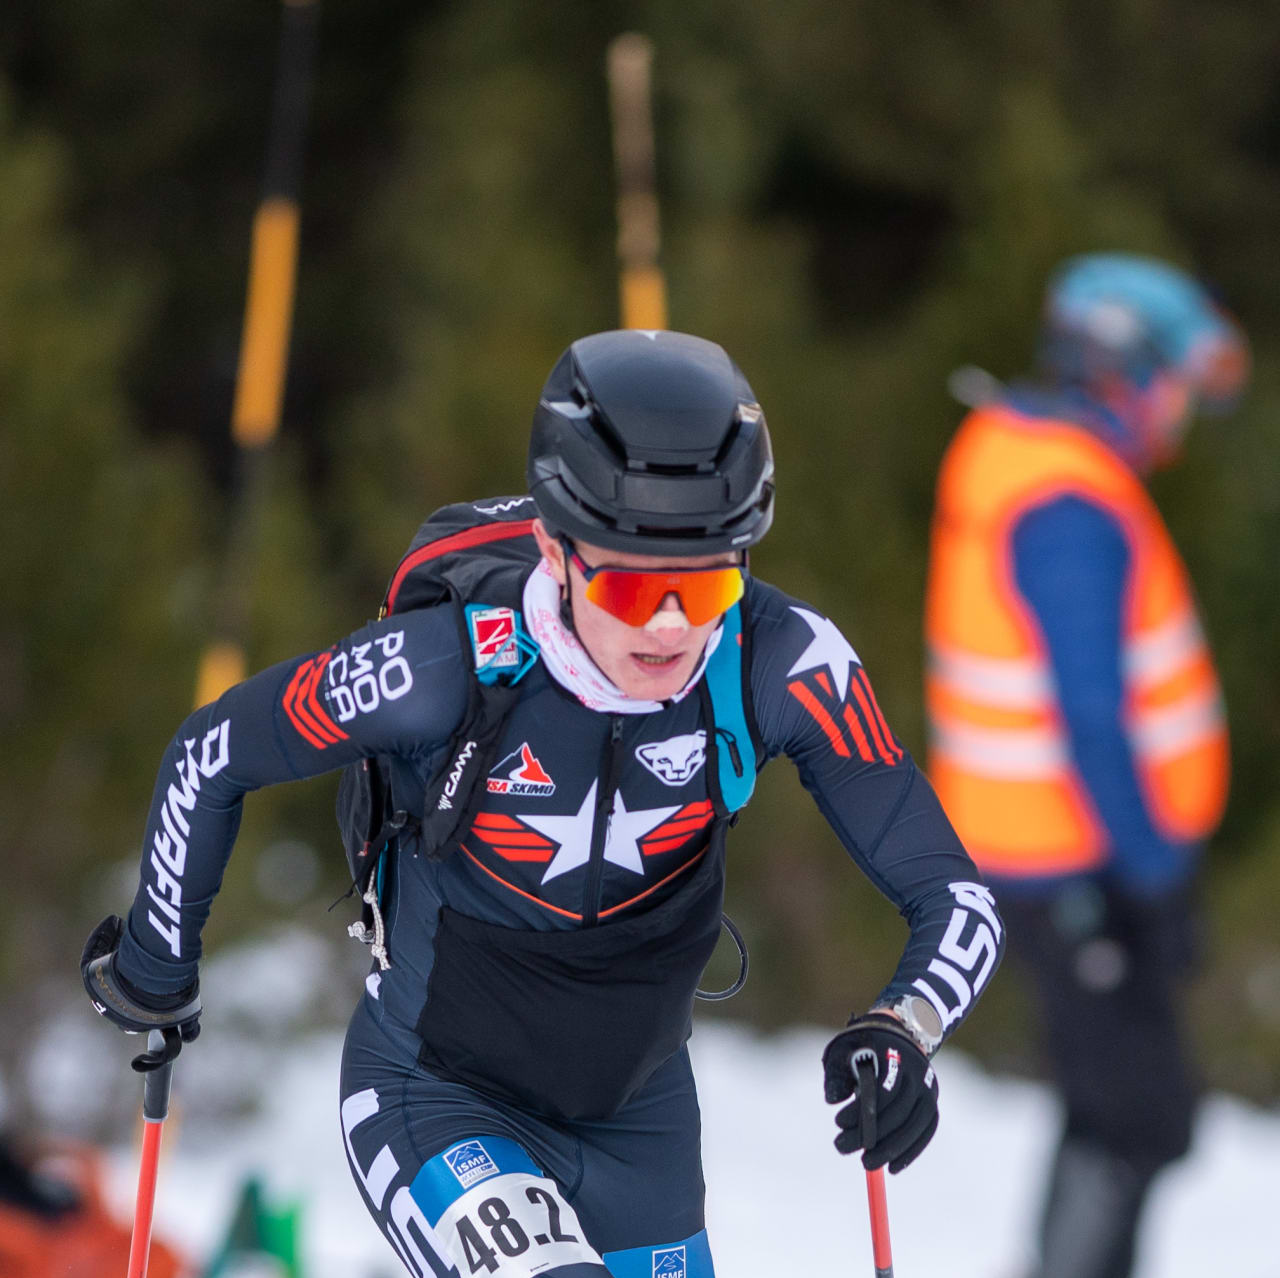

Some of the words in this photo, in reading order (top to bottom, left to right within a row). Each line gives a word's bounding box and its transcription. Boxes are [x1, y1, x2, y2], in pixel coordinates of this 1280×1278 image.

[509, 783, 555, 795] SKIMO
[146, 718, 231, 958] DYNAFIT
[911, 881, 1002, 1032] USA
[456, 1154, 487, 1173] ISMF
[455, 1186, 580, 1275] 48.2
